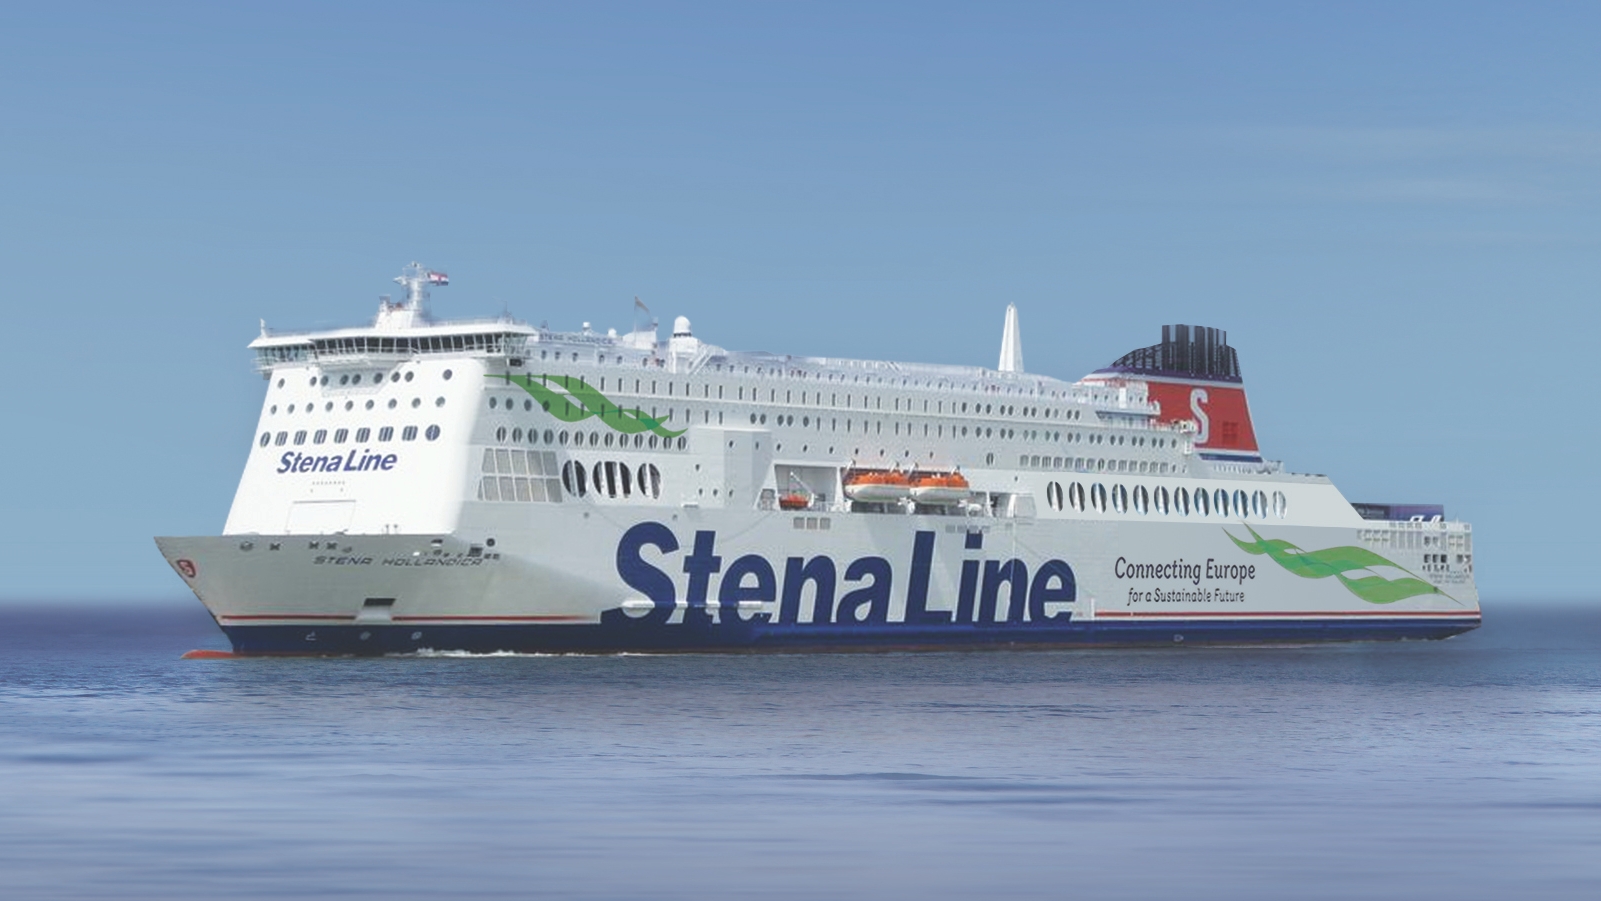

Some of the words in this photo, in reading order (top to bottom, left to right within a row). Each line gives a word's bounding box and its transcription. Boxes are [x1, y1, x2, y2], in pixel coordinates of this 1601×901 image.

[1191, 388, 1209, 444] S
[276, 451, 343, 474] Stena
[343, 448, 398, 471] Line
[313, 556, 374, 565] STENA
[381, 557, 484, 567] HOLLANDICA
[600, 521, 893, 624] Stena
[904, 529, 1078, 623] Line
[1114, 556, 1201, 586] Connecting
[1206, 558, 1255, 585] Europe
[1127, 587, 1144, 606] for
[1145, 591, 1152, 602] a
[1154, 587, 1212, 603] Sustainable
[1213, 588, 1245, 602] Future
